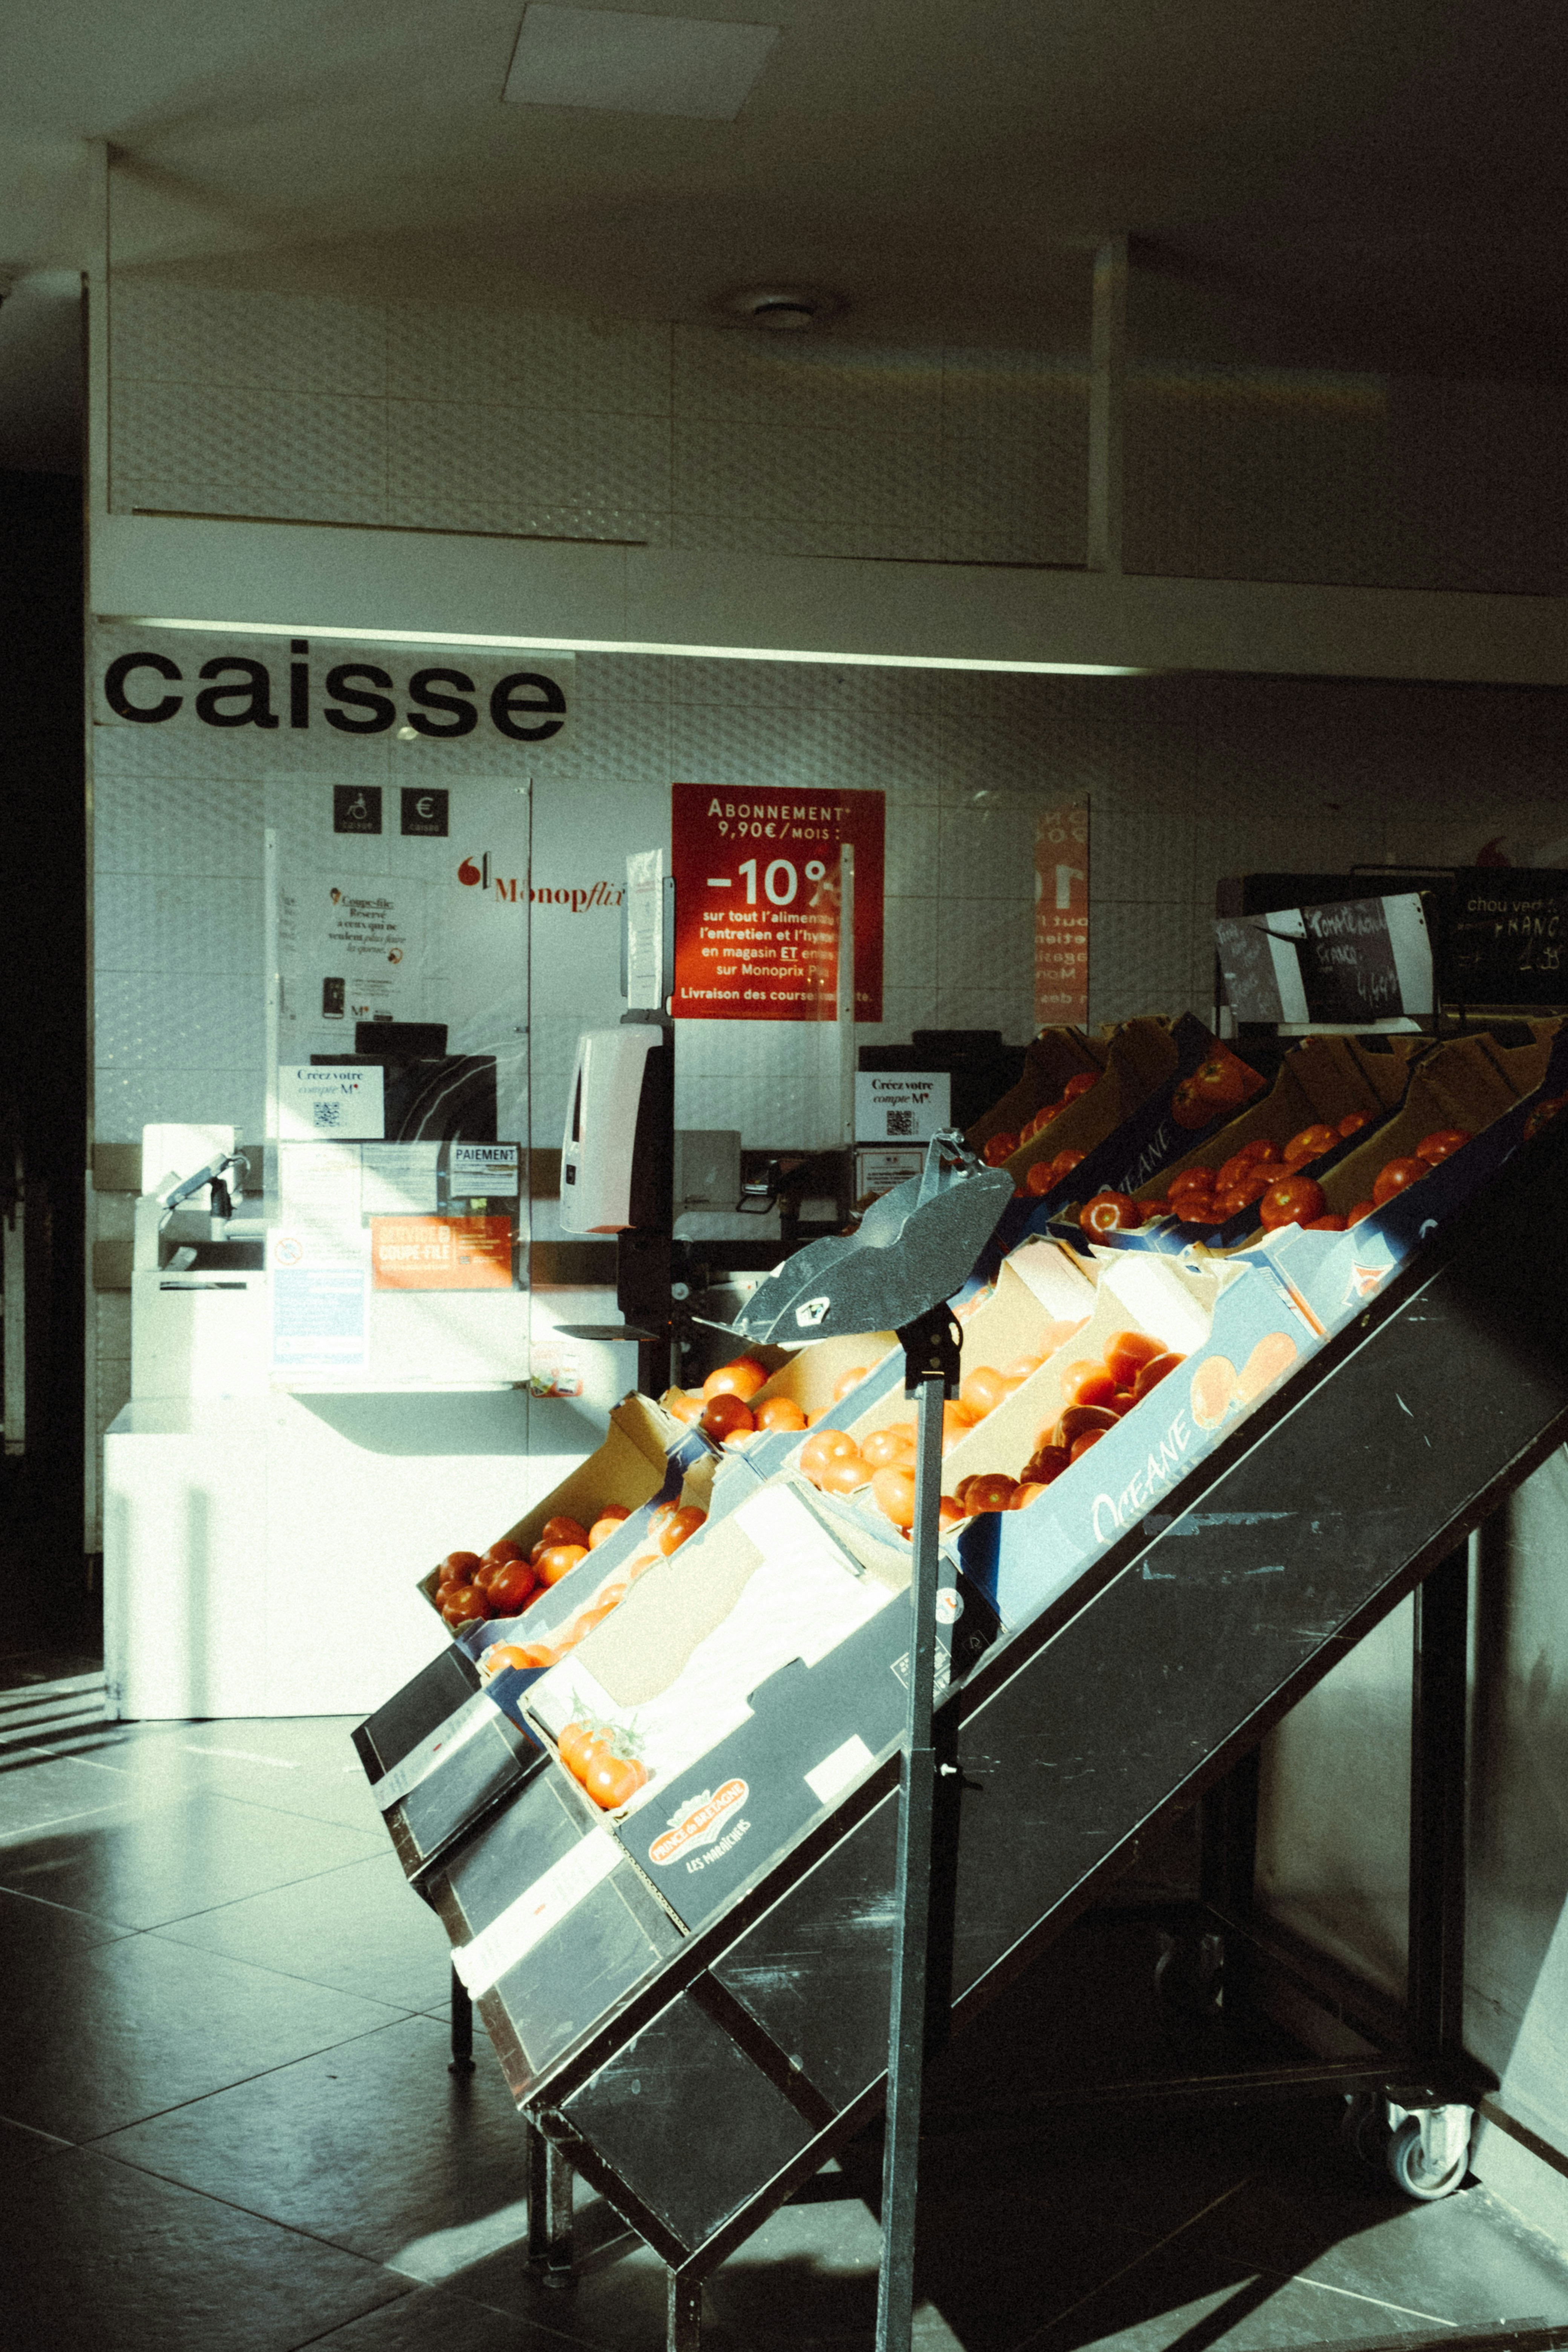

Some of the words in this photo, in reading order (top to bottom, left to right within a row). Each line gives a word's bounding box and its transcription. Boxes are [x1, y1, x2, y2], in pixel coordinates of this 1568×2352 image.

[104, 639, 567, 741] caisse
[1467, 896, 1507, 912] chou
[703, 912, 724, 922] sur
[729, 911, 758, 922] tout
[700, 927, 772, 941] l'entretien
[776, 930, 790, 940] et
[702, 947, 718, 957] en
[723, 947, 776, 961] magasin
[781, 947, 797, 960] ET
[717, 965, 737, 975] sur
[743, 964, 804, 979] Monoprix
[681, 987, 740, 1000] Livraison
[744, 989, 766, 1000] des
[297, 1069, 331, 1081] Créez
[333, 1070, 364, 1081] votre
[872, 1079, 903, 1090] Créez
[905, 1080, 934, 1090] votre
[873, 1093, 911, 1106] compte
[456, 1148, 515, 1160] PAIEMENT
[379, 1245, 450, 1260] COUPE-FILE
[652, 1828, 688, 1859] PRINCE
[693, 1783, 744, 1827] BRETAGNE
[686, 1857, 704, 1874] LES
